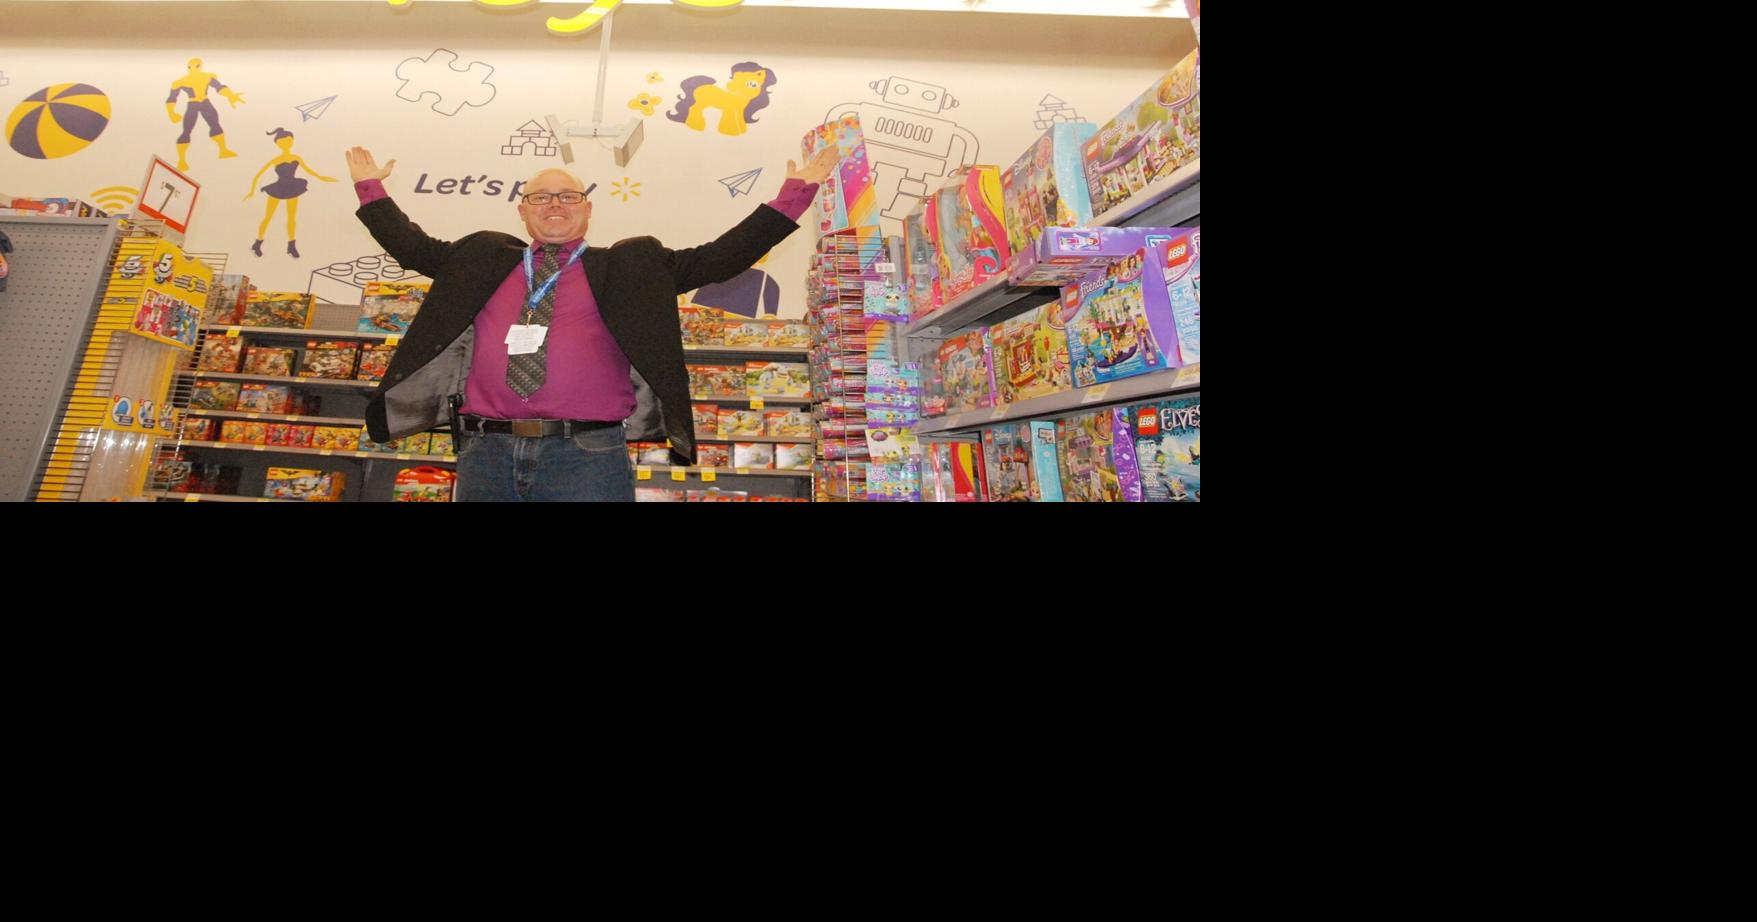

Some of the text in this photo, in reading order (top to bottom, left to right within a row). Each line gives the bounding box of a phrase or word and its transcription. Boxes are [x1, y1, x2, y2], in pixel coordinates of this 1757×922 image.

[414, 173, 504, 196] Let's
[1080, 274, 1105, 297] Friends
[1139, 415, 1156, 428] LEGO
